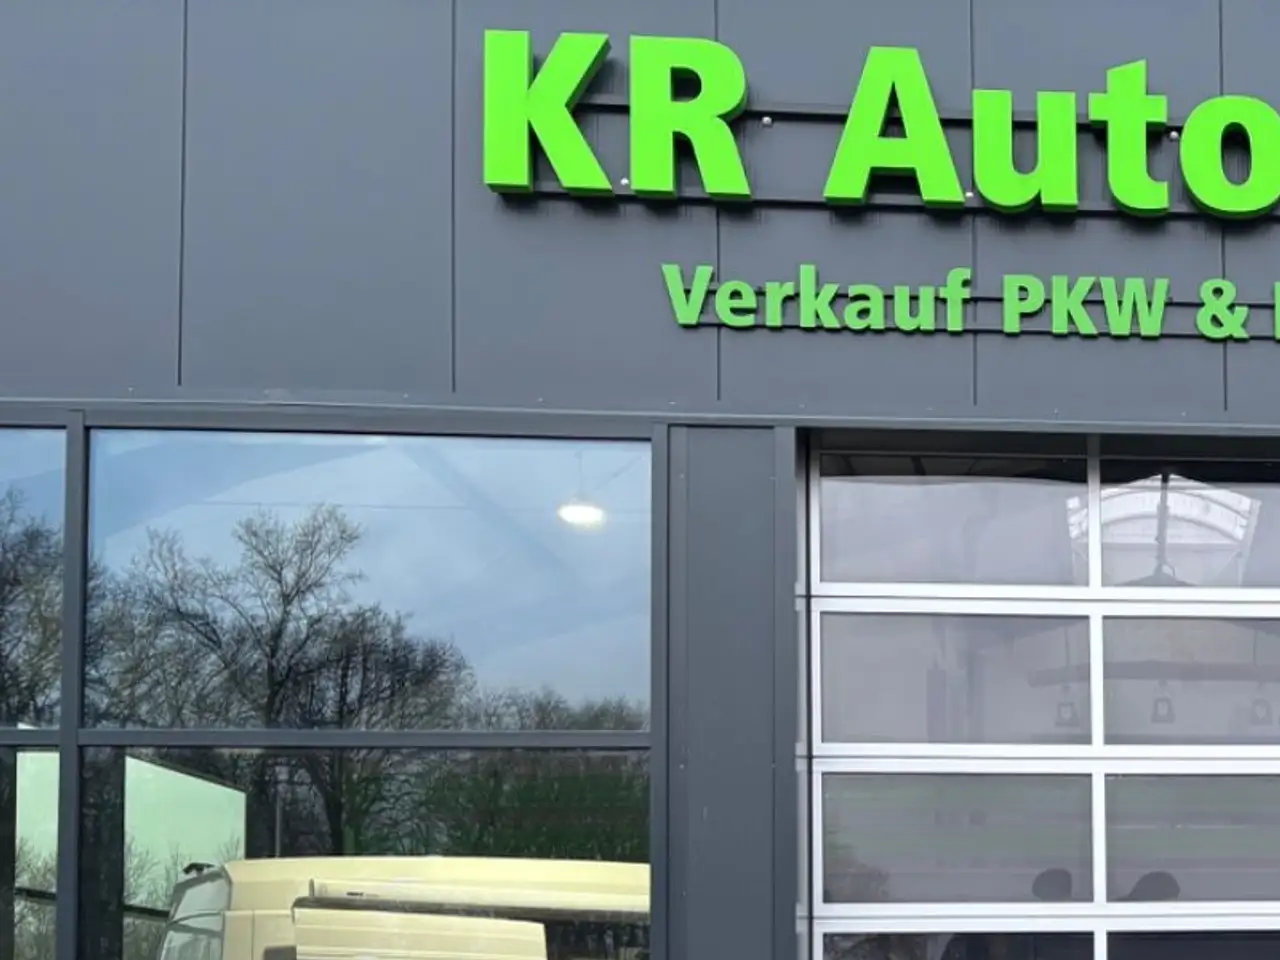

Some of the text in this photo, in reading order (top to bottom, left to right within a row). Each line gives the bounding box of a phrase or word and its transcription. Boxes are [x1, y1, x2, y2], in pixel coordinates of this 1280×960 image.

[482, 29, 752, 200] KR
[662, 263, 973, 333] Verkauf
[1002, 274, 1170, 338] PKW
[1196, 278, 1249, 340] &
